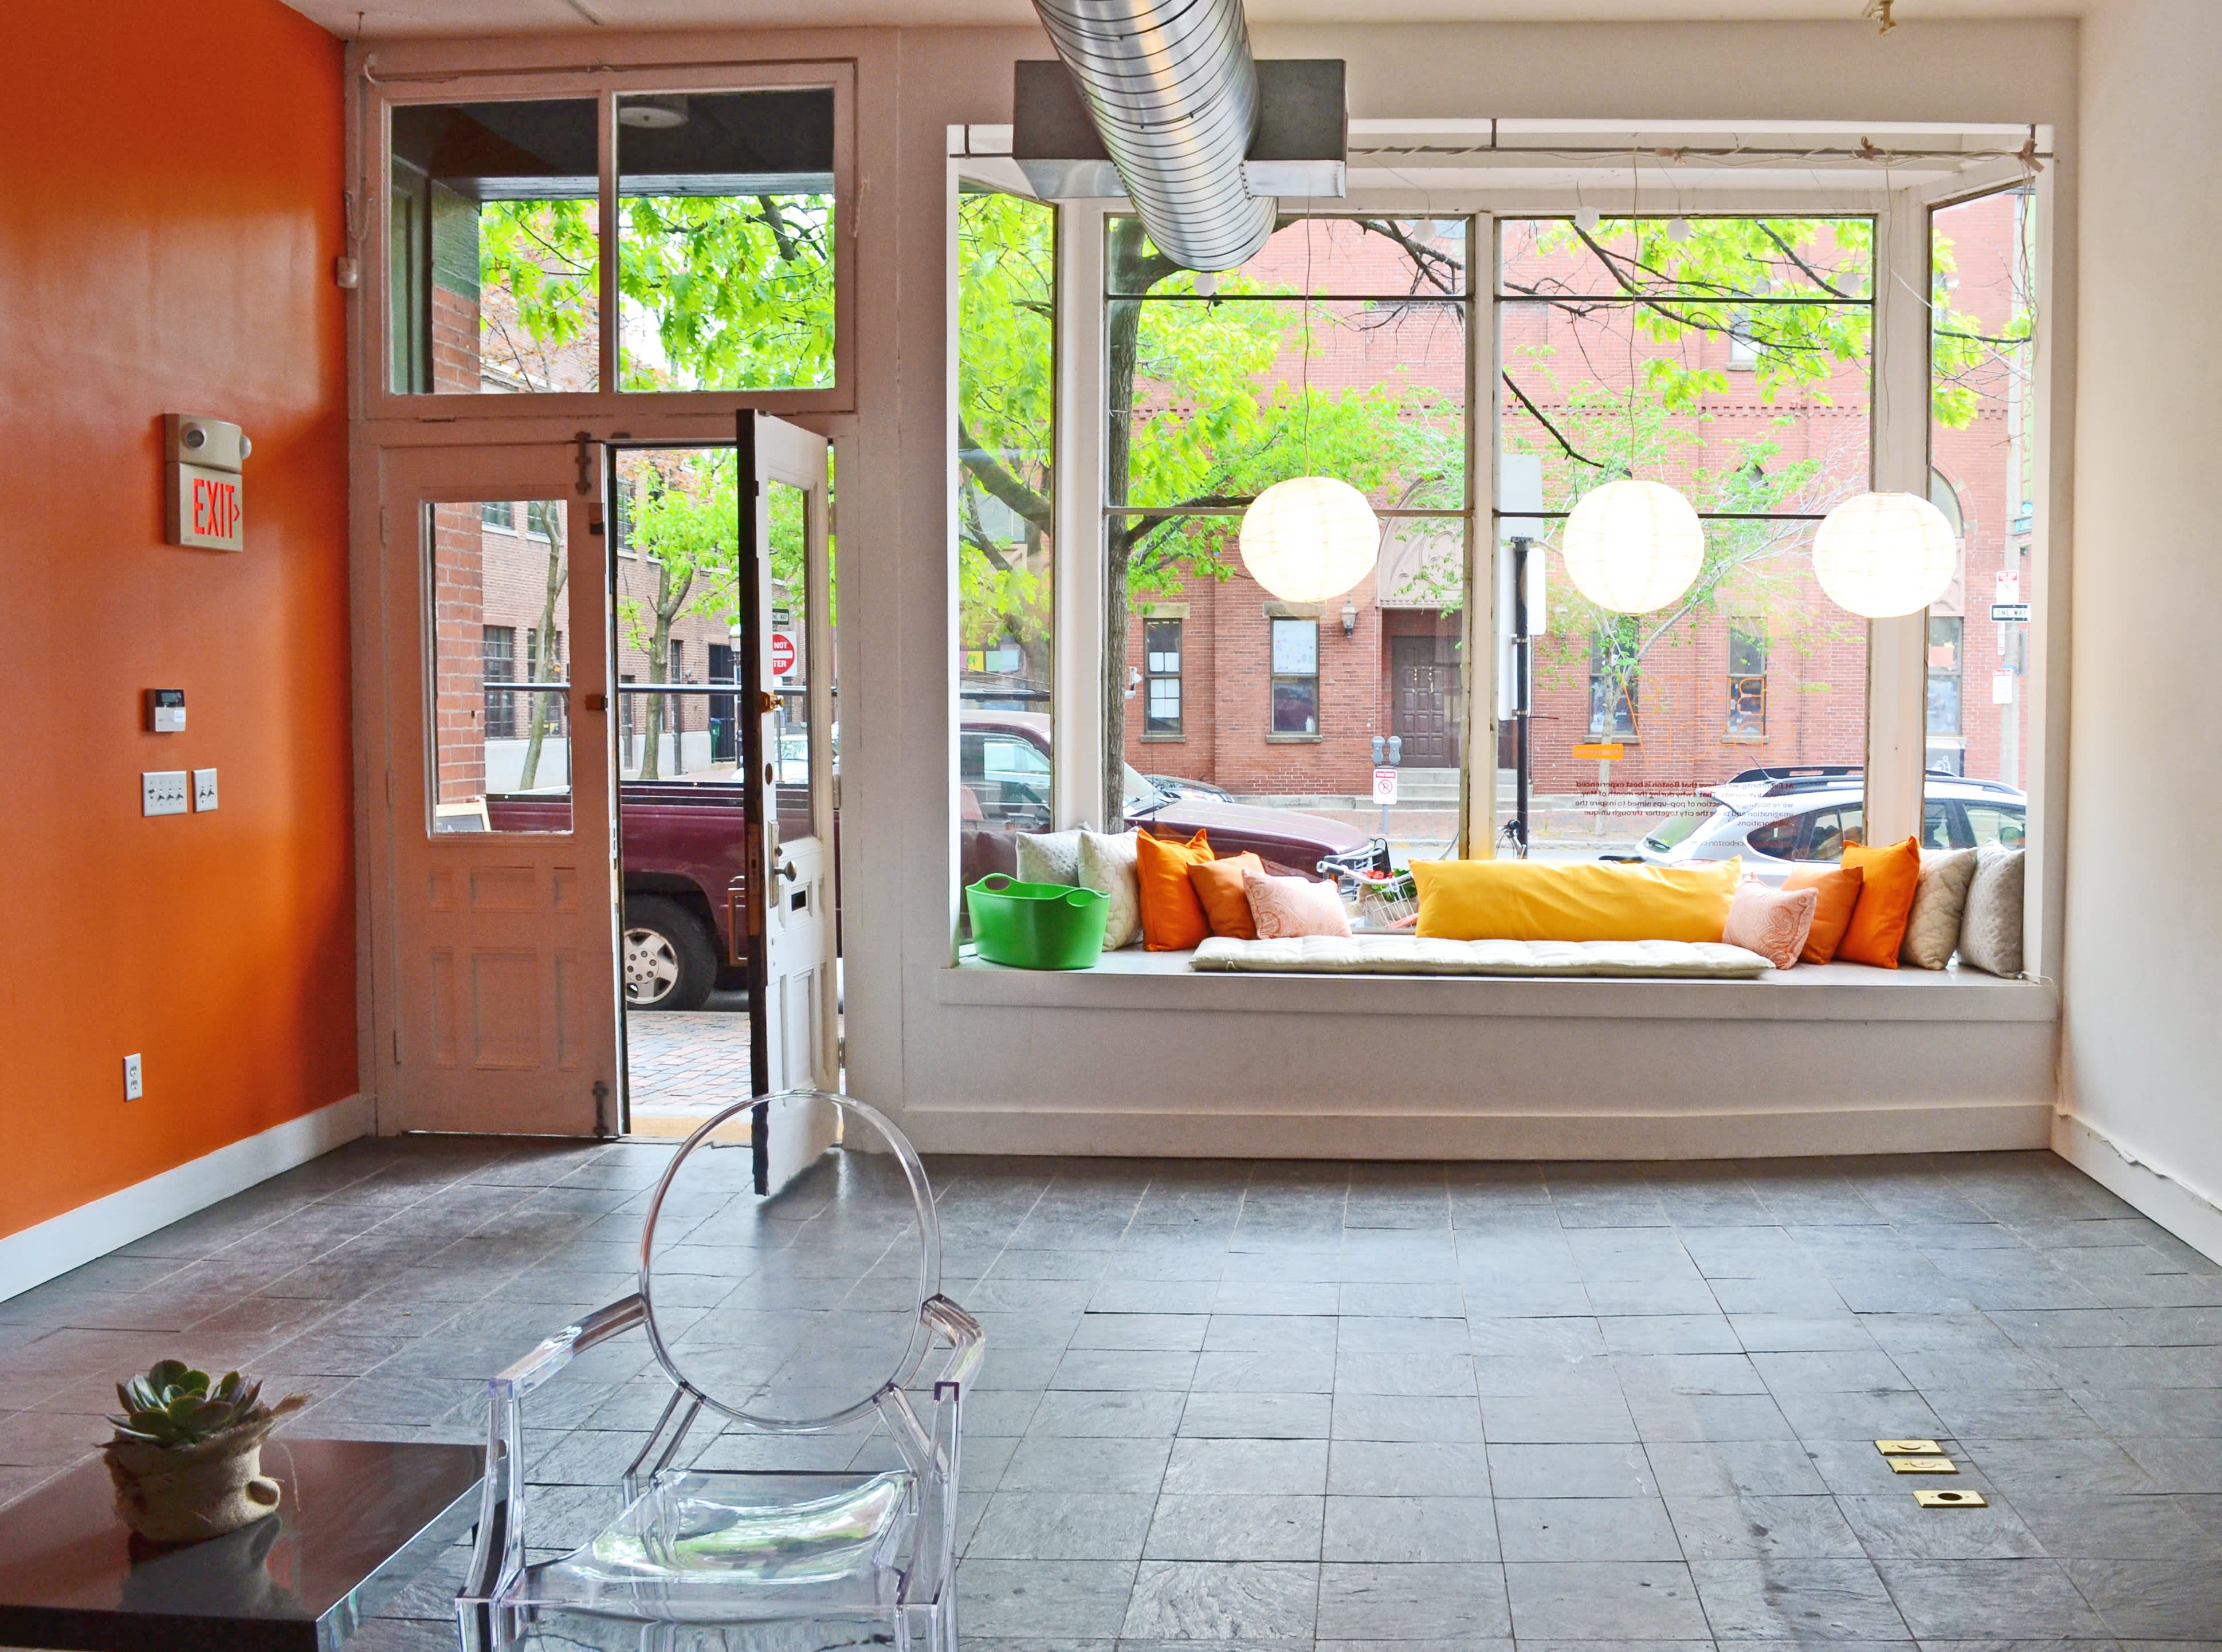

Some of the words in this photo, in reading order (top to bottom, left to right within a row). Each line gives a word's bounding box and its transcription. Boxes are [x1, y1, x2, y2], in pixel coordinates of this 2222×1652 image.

[194, 478, 234, 538] EXIT
[774, 641, 788, 649] NOT
[774, 659, 787, 667] TER
